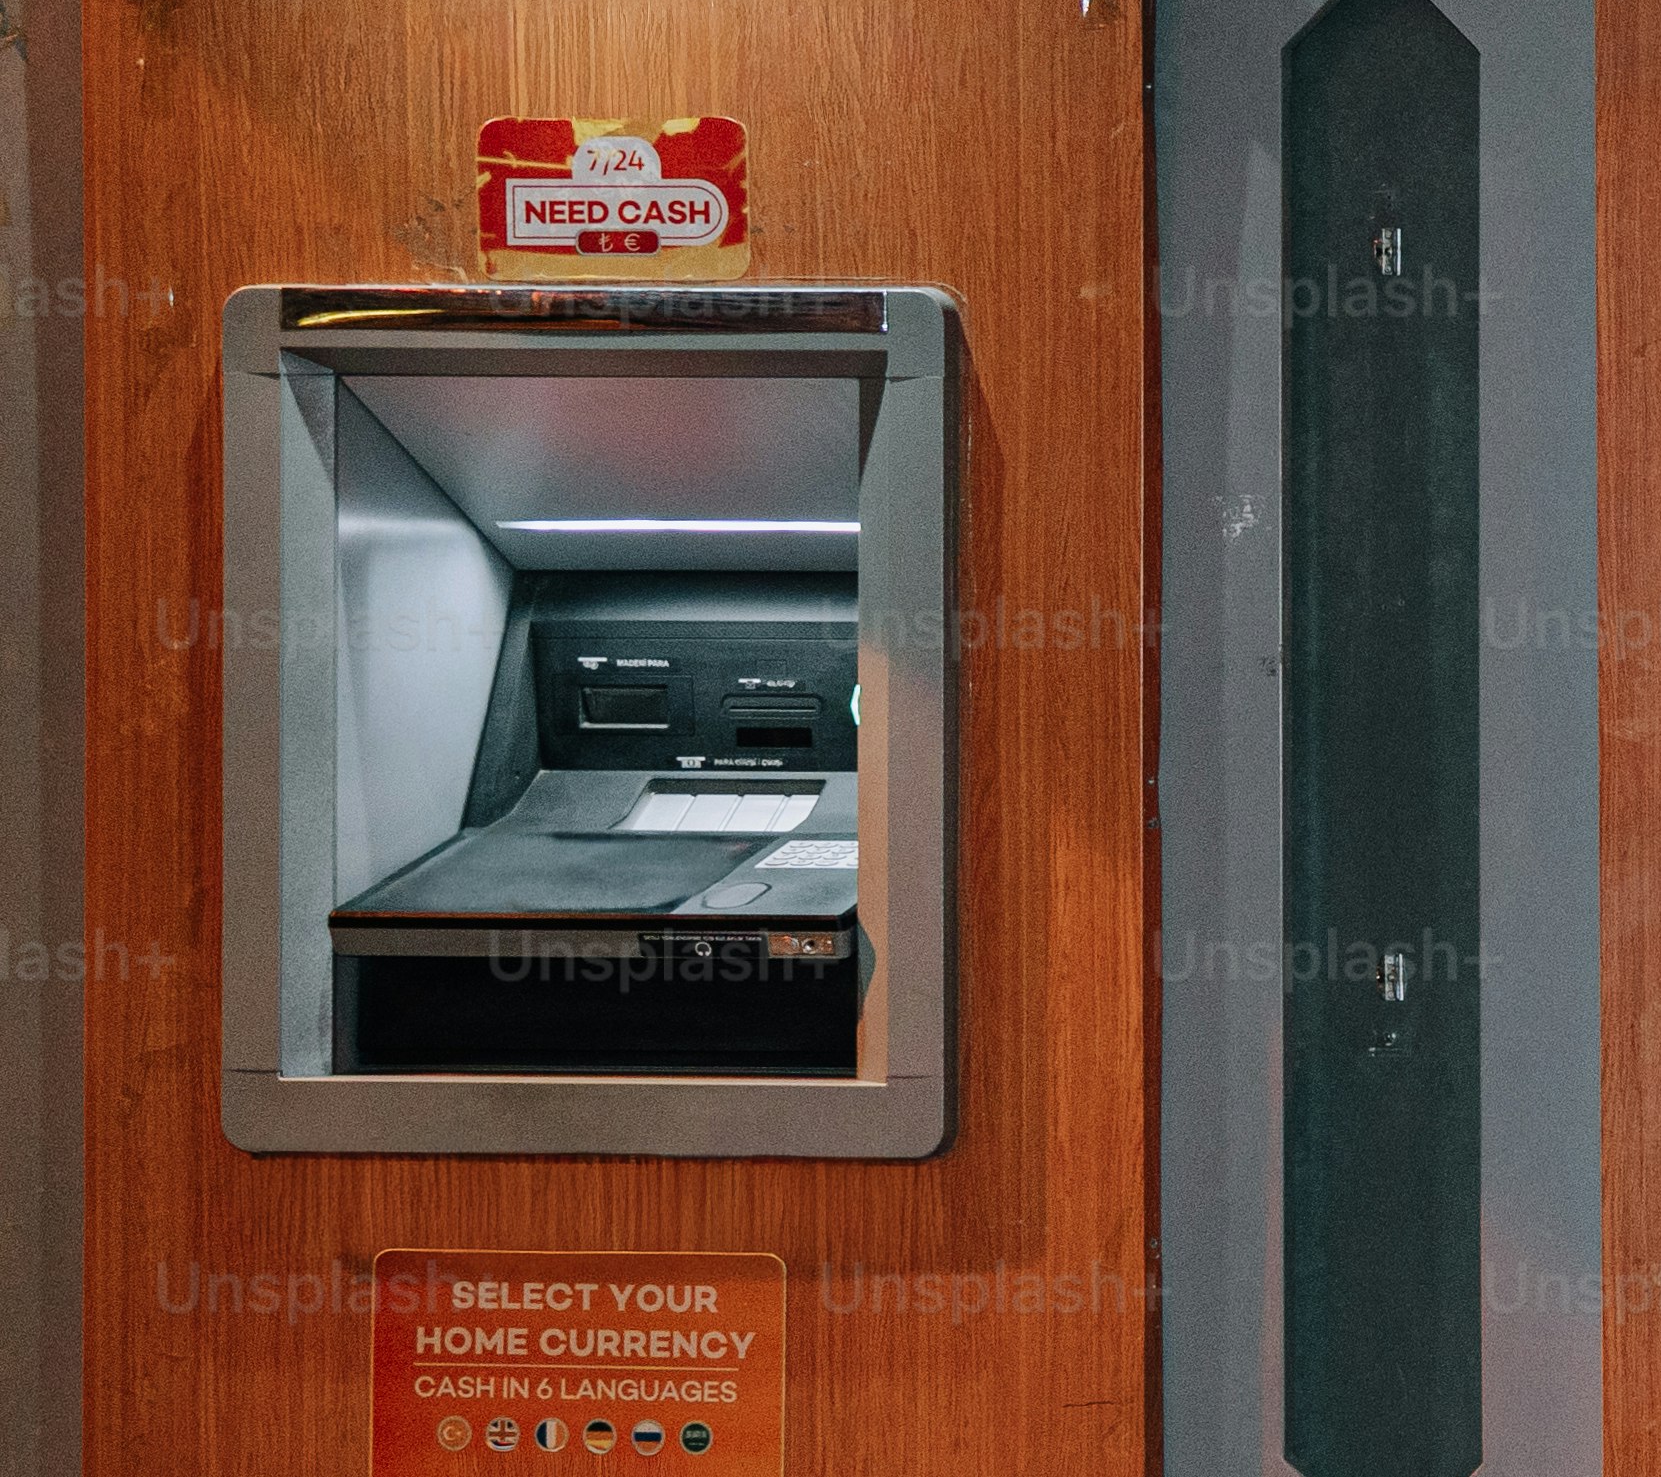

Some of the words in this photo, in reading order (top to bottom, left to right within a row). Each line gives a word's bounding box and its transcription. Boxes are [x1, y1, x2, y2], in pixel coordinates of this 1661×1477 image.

[586, 149, 645, 175] 7/24
[524, 200, 609, 224] NEED
[618, 200, 711, 224] CASH
[624, 233, 641, 252] €
[452, 1281, 598, 1311] SELECT
[608, 1283, 718, 1313] YOUR
[416, 1327, 528, 1356] HOME
[539, 1328, 756, 1359] CURRENCY
[414, 1376, 495, 1399] CASH
[502, 1377, 529, 1400] IN
[536, 1377, 553, 1400] 6
[560, 1379, 738, 1403] LANGUAGES
